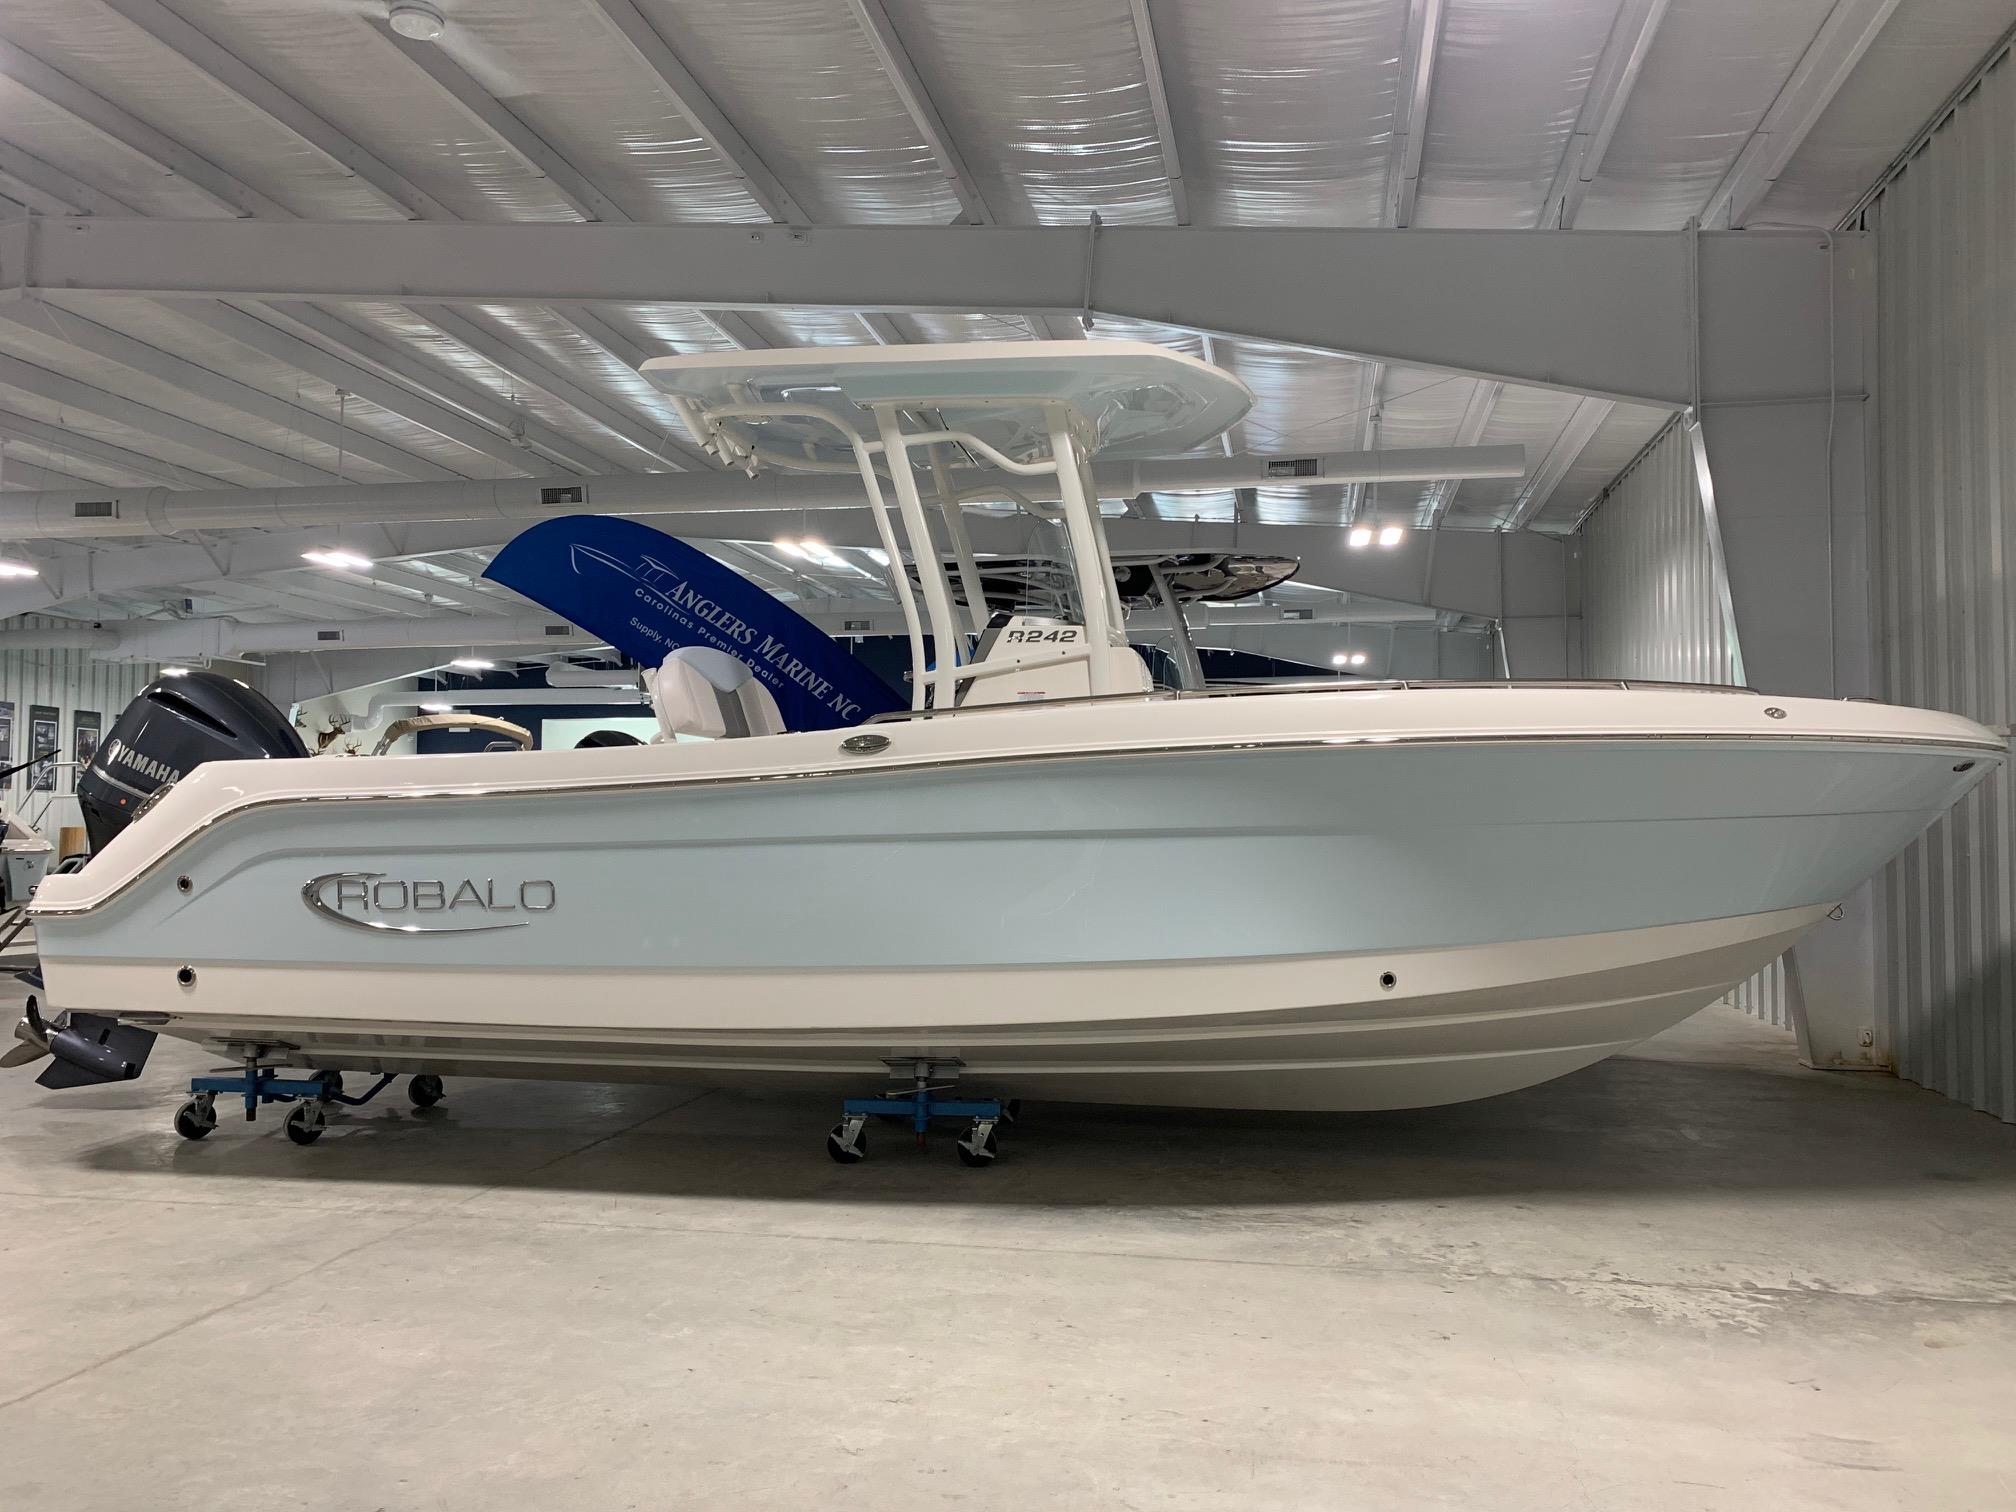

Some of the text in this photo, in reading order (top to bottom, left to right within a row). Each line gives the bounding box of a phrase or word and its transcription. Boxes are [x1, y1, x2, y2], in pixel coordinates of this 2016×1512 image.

[630, 617, 680, 651] Supply, NC
[635, 588, 784, 688] Carolinas Premier Dealer
[665, 581, 861, 720] ANGLERS MARINE NC
[1006, 630, 1077, 643] R242
[118, 744, 180, 784] YAMAHA
[336, 878, 556, 911] ROBALO
